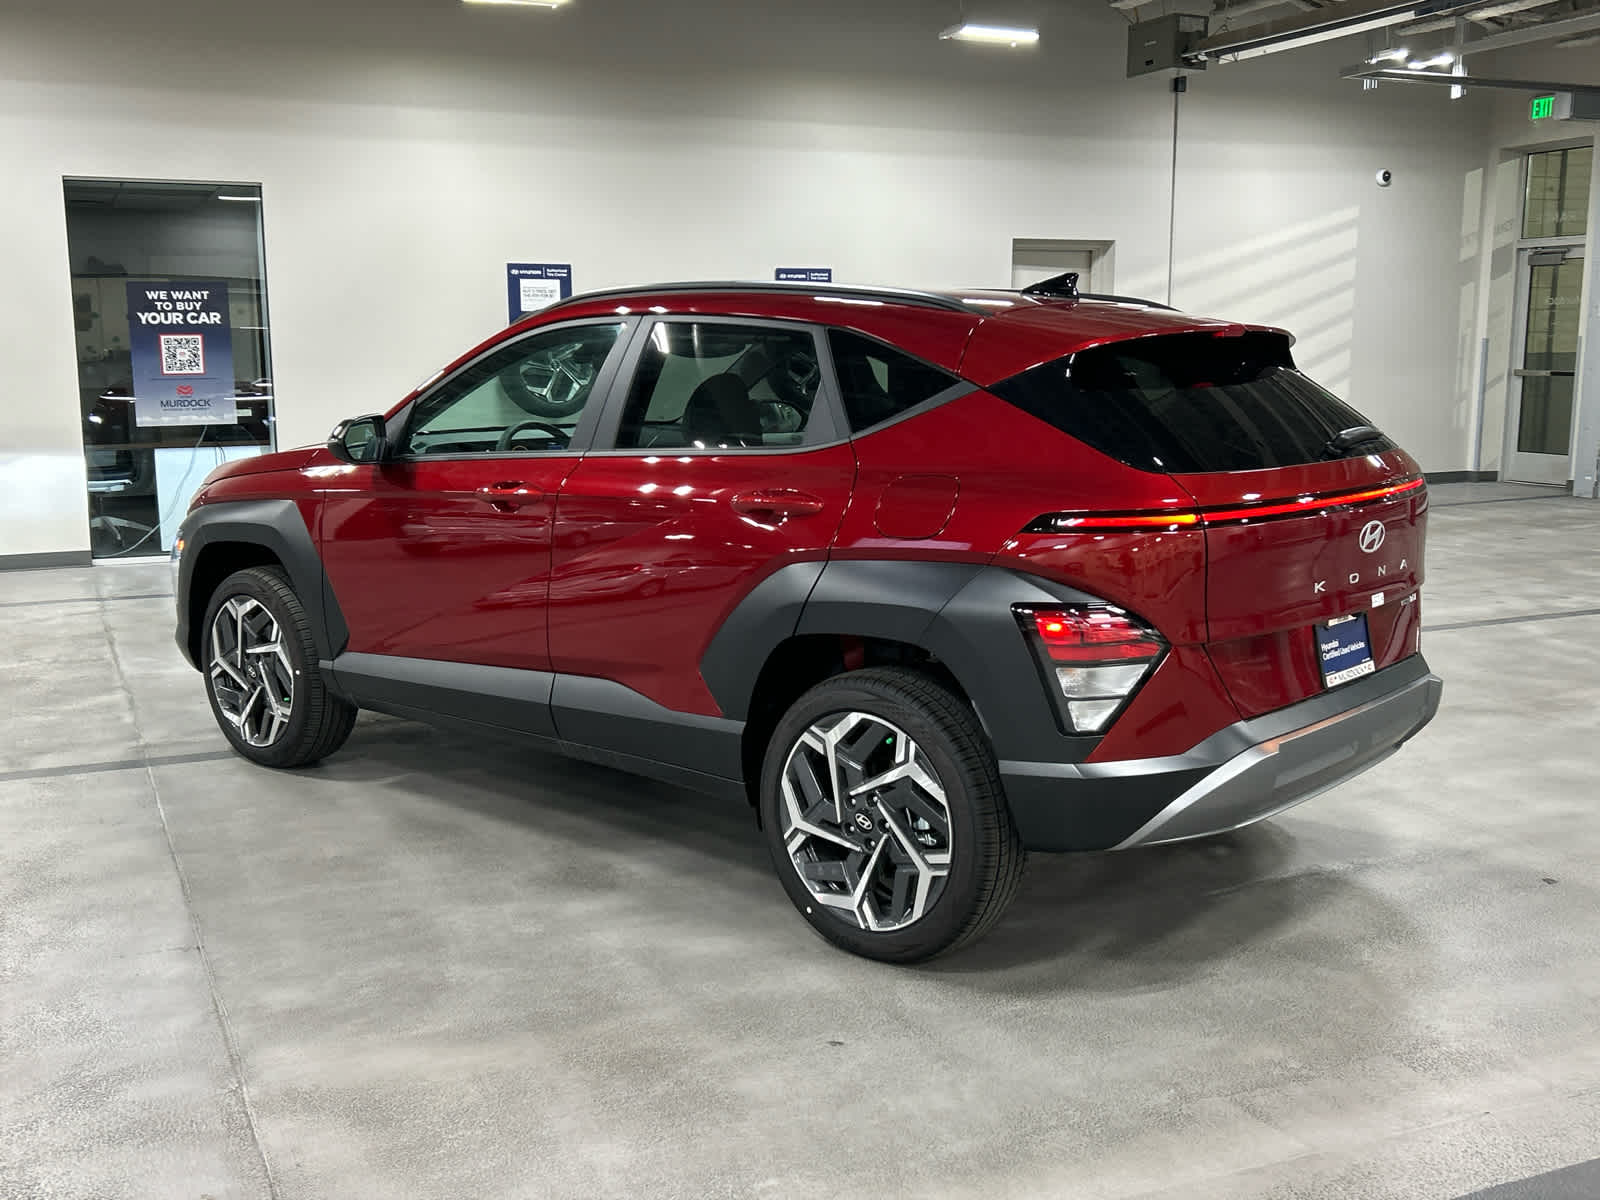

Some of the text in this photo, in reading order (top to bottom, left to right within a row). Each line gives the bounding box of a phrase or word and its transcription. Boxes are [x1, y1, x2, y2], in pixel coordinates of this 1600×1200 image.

[1532, 96, 1555, 119] EXIT
[145, 290, 210, 300] WE WANT
[155, 301, 202, 311] TO BUY
[137, 312, 222, 325] YOUR CAR
[160, 399, 211, 408] MURDOCK
